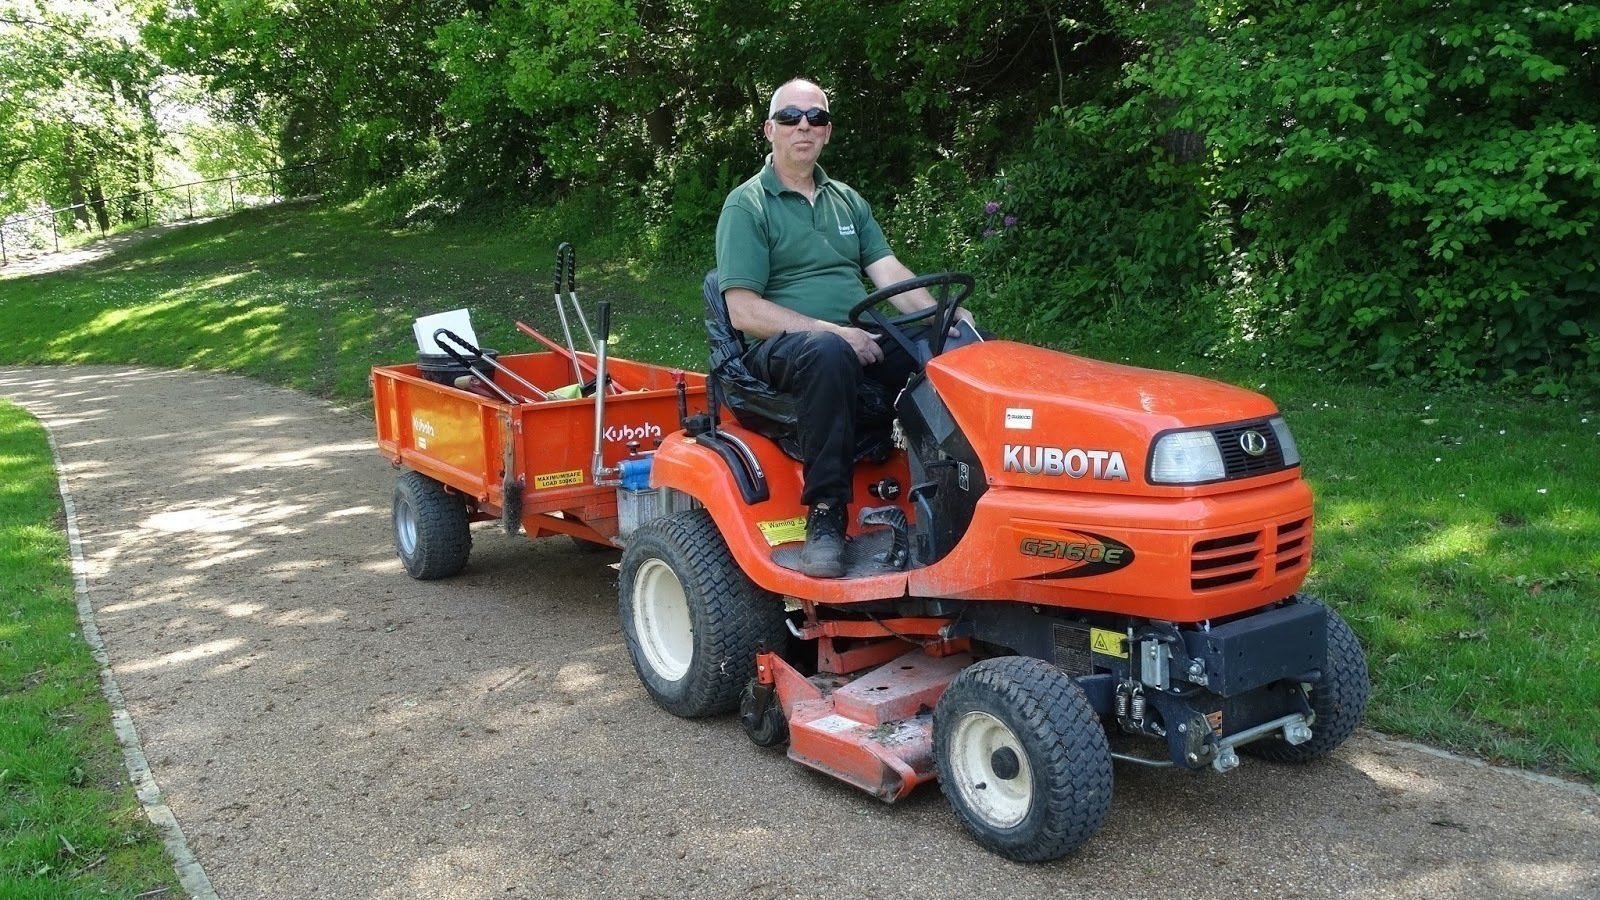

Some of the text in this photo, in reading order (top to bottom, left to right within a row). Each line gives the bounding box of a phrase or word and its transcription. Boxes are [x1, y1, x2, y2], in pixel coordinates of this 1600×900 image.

[602, 422, 662, 442] Kubota
[1003, 444, 1129, 482] KUBOTA
[537, 474, 566, 482] MAXIMUM
[767, 520, 795, 529] Warning
[1020, 537, 1124, 564] G2160E
